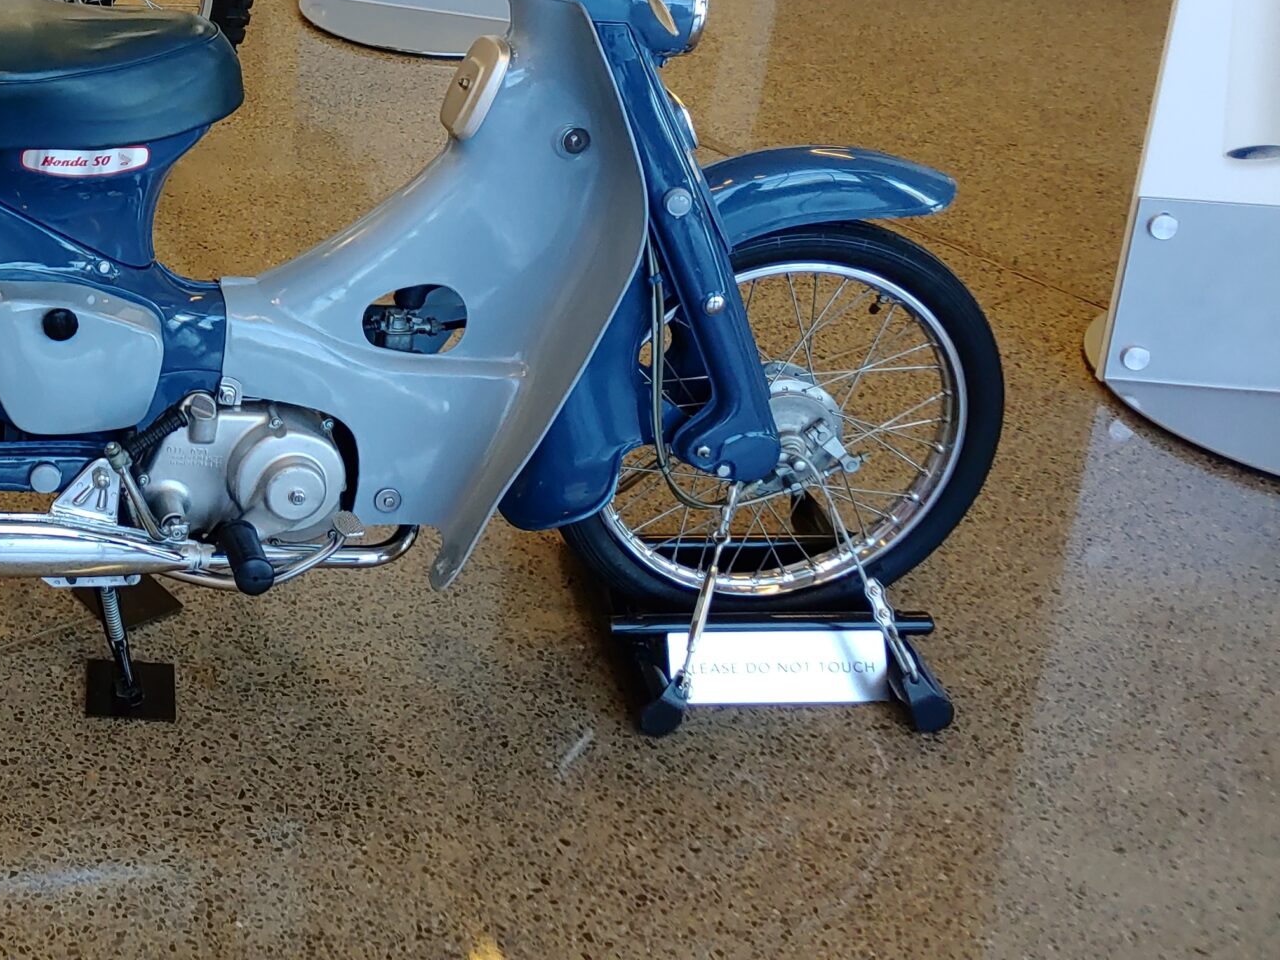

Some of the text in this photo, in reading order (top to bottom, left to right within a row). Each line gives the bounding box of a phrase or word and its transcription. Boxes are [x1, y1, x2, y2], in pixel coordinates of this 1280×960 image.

[40, 155, 113, 167] Honda 50
[745, 662, 771, 674] DO
[819, 661, 875, 674] TOUCH
